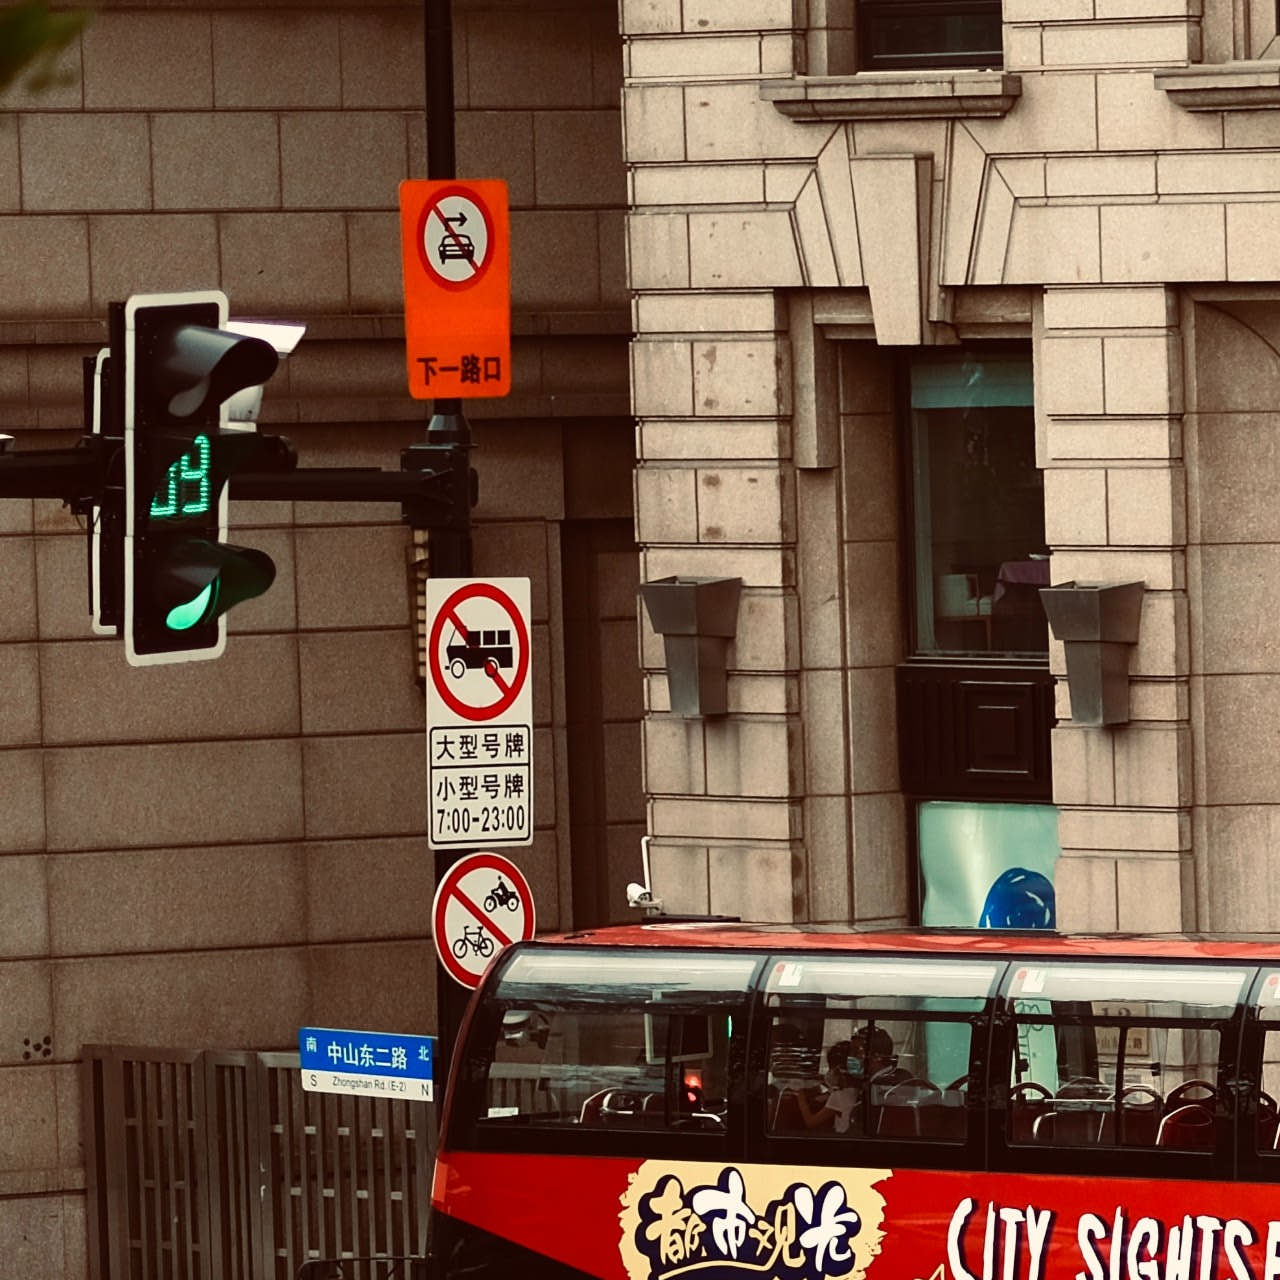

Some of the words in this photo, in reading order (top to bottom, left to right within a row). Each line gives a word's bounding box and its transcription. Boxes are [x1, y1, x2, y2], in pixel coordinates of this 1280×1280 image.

[417, 354, 501, 386] 下一路口
[436, 733, 524, 760] 大型号牌
[436, 773, 525, 801] 小型号牌
[437, 805, 525, 834] 7:00-23:00
[306, 1036, 317, 1052] 南
[327, 1041, 408, 1069] 中山东二路
[418, 1046, 429, 1061] 北
[310, 1074, 318, 1087] S
[332, 1075, 373, 1090] Zhongshan
[421, 1084, 429, 1096] N
[645, 1169, 858, 1274] 都市观光
